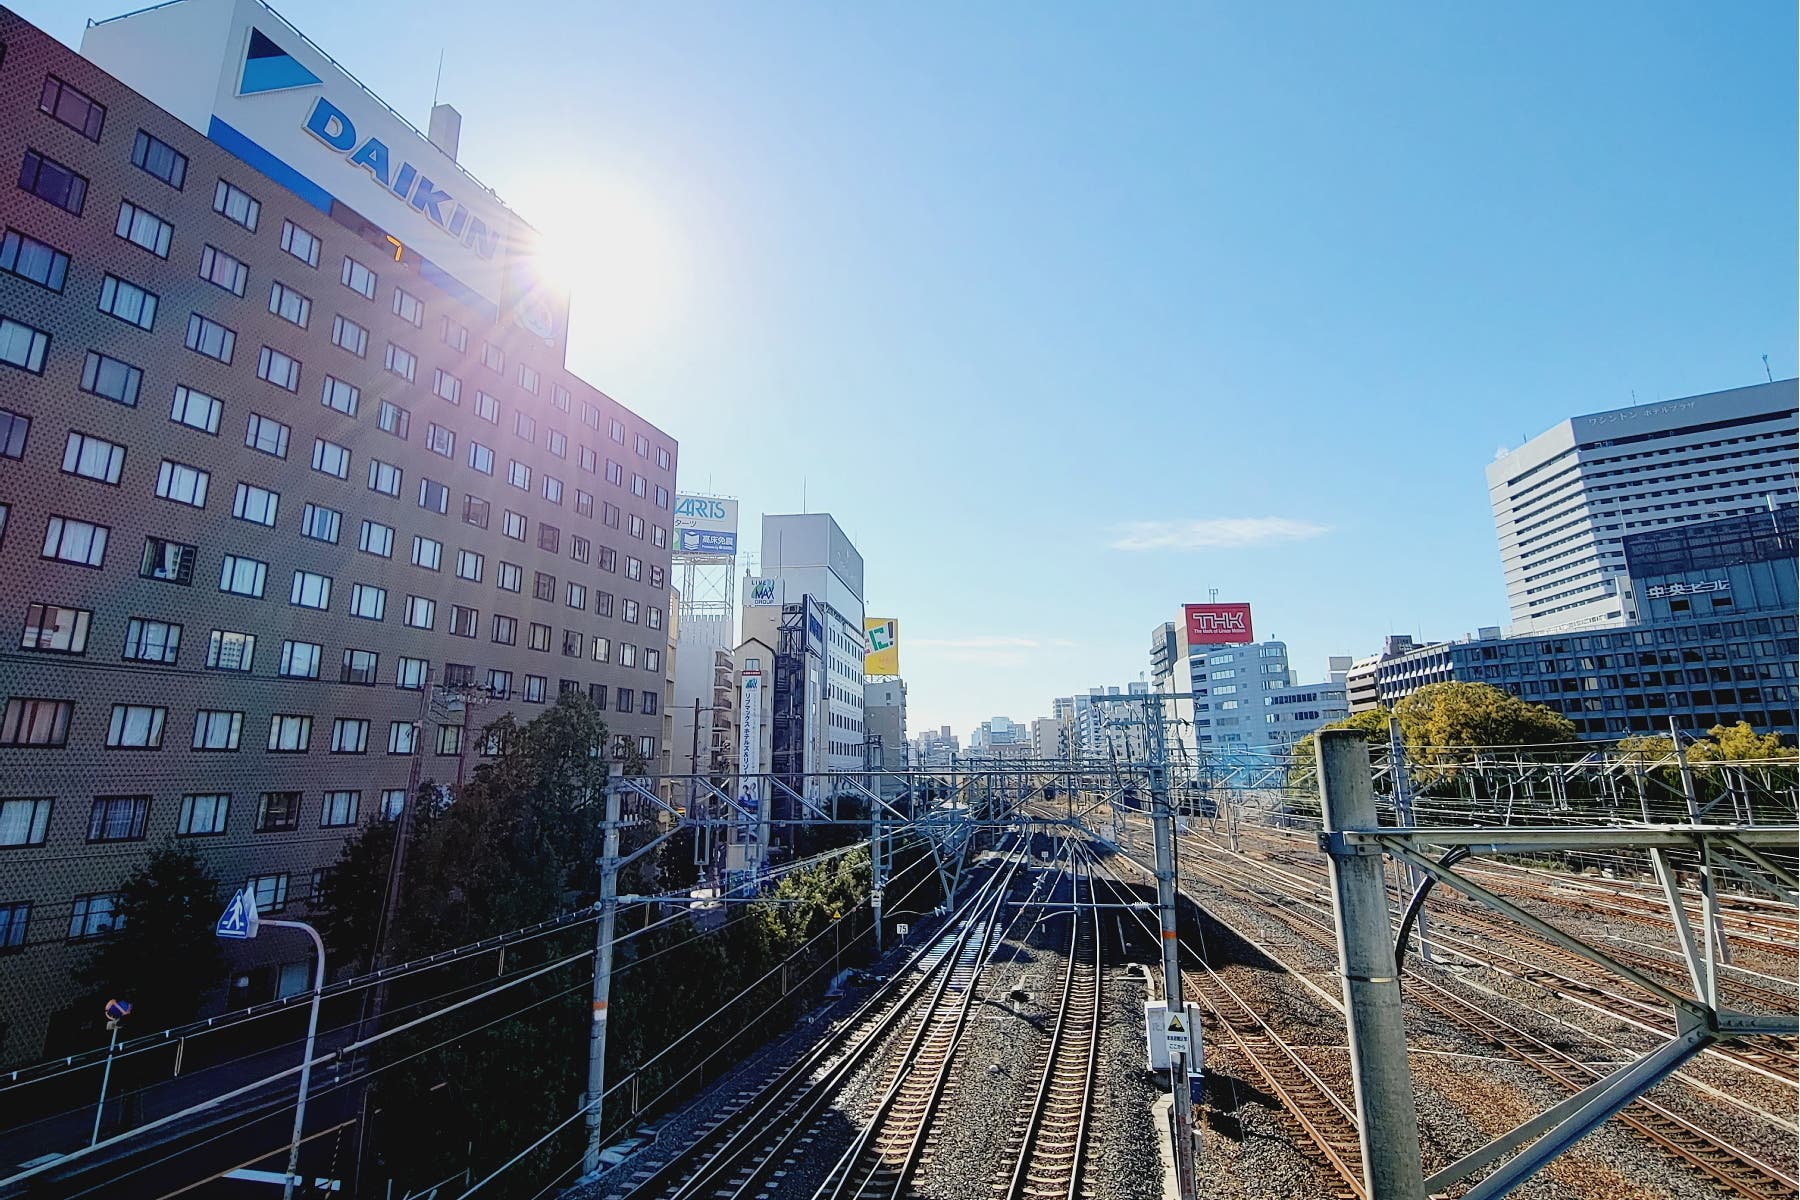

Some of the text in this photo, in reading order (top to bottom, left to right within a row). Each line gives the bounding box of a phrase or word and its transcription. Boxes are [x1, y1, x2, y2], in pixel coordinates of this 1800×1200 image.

[302, 96, 501, 261] DAIKIN
[1588, 412, 1637, 426] ワシントン
[675, 497, 726, 519] ARTS
[755, 586, 775, 599] MAX
[1648, 579, 1728, 599] 中央ビル
[1193, 612, 1244, 628] THK
